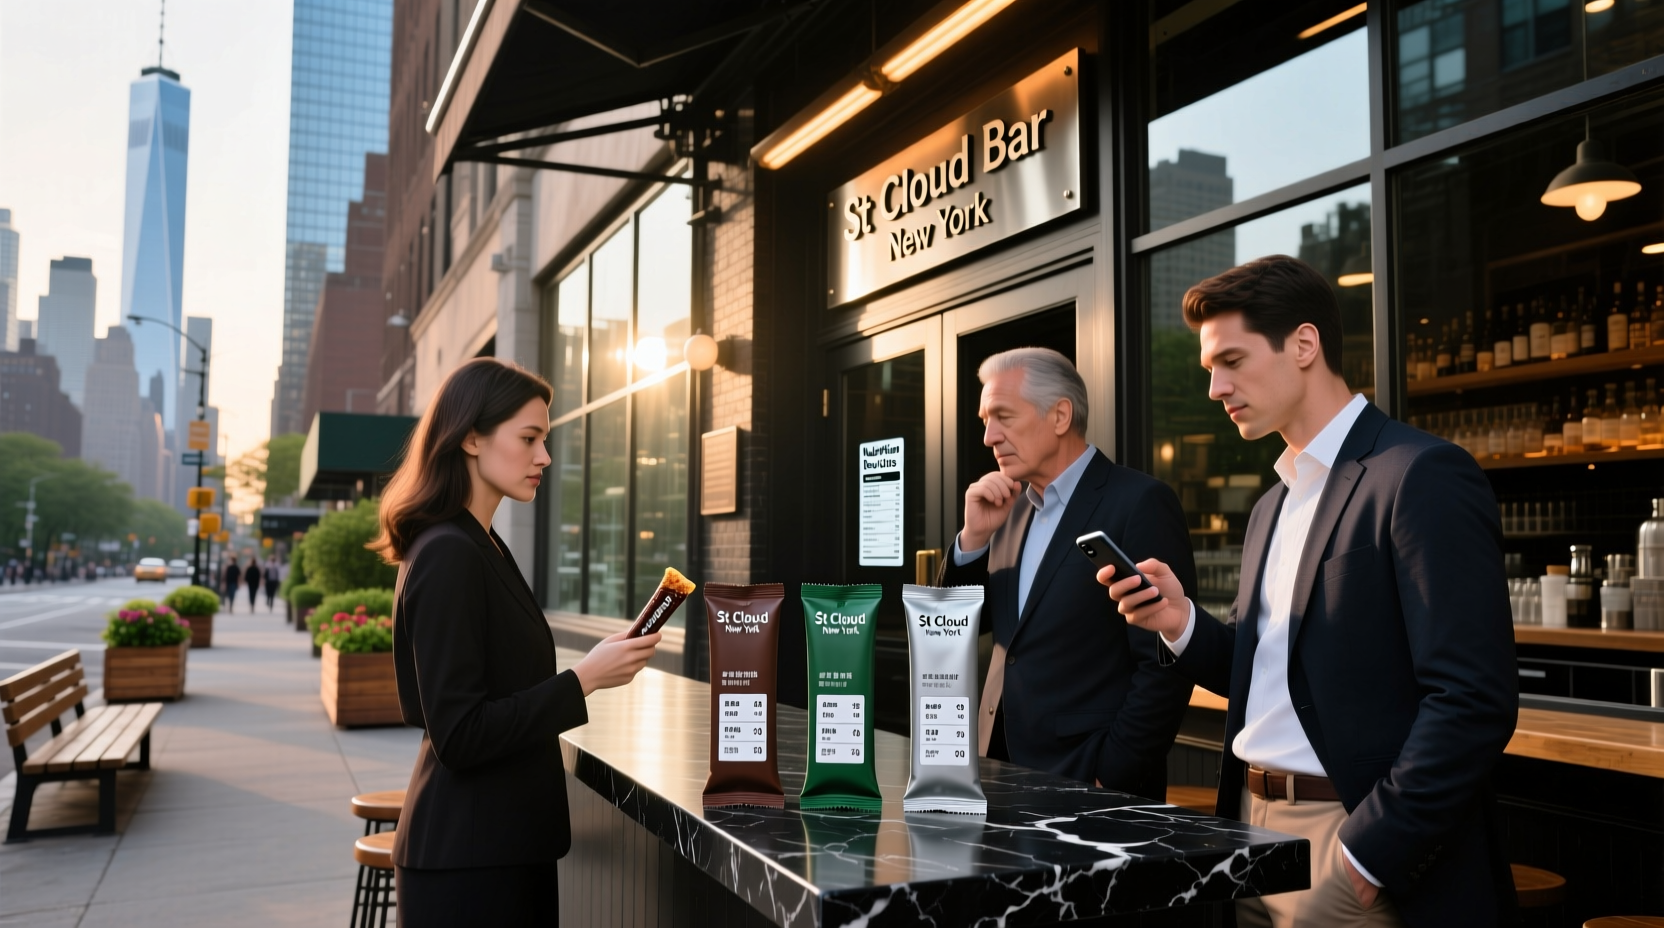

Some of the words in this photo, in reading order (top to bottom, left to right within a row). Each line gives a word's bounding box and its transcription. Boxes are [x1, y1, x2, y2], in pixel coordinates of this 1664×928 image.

[844, 195, 875, 242] St
[880, 134, 973, 221] Cloud
[982, 109, 1053, 173] Bar
[889, 223, 935, 261] New
[936, 192, 992, 239] York
[733, 611, 769, 623] Cloud
[830, 612, 866, 625] Cloud
[934, 614, 969, 627] Cloud
